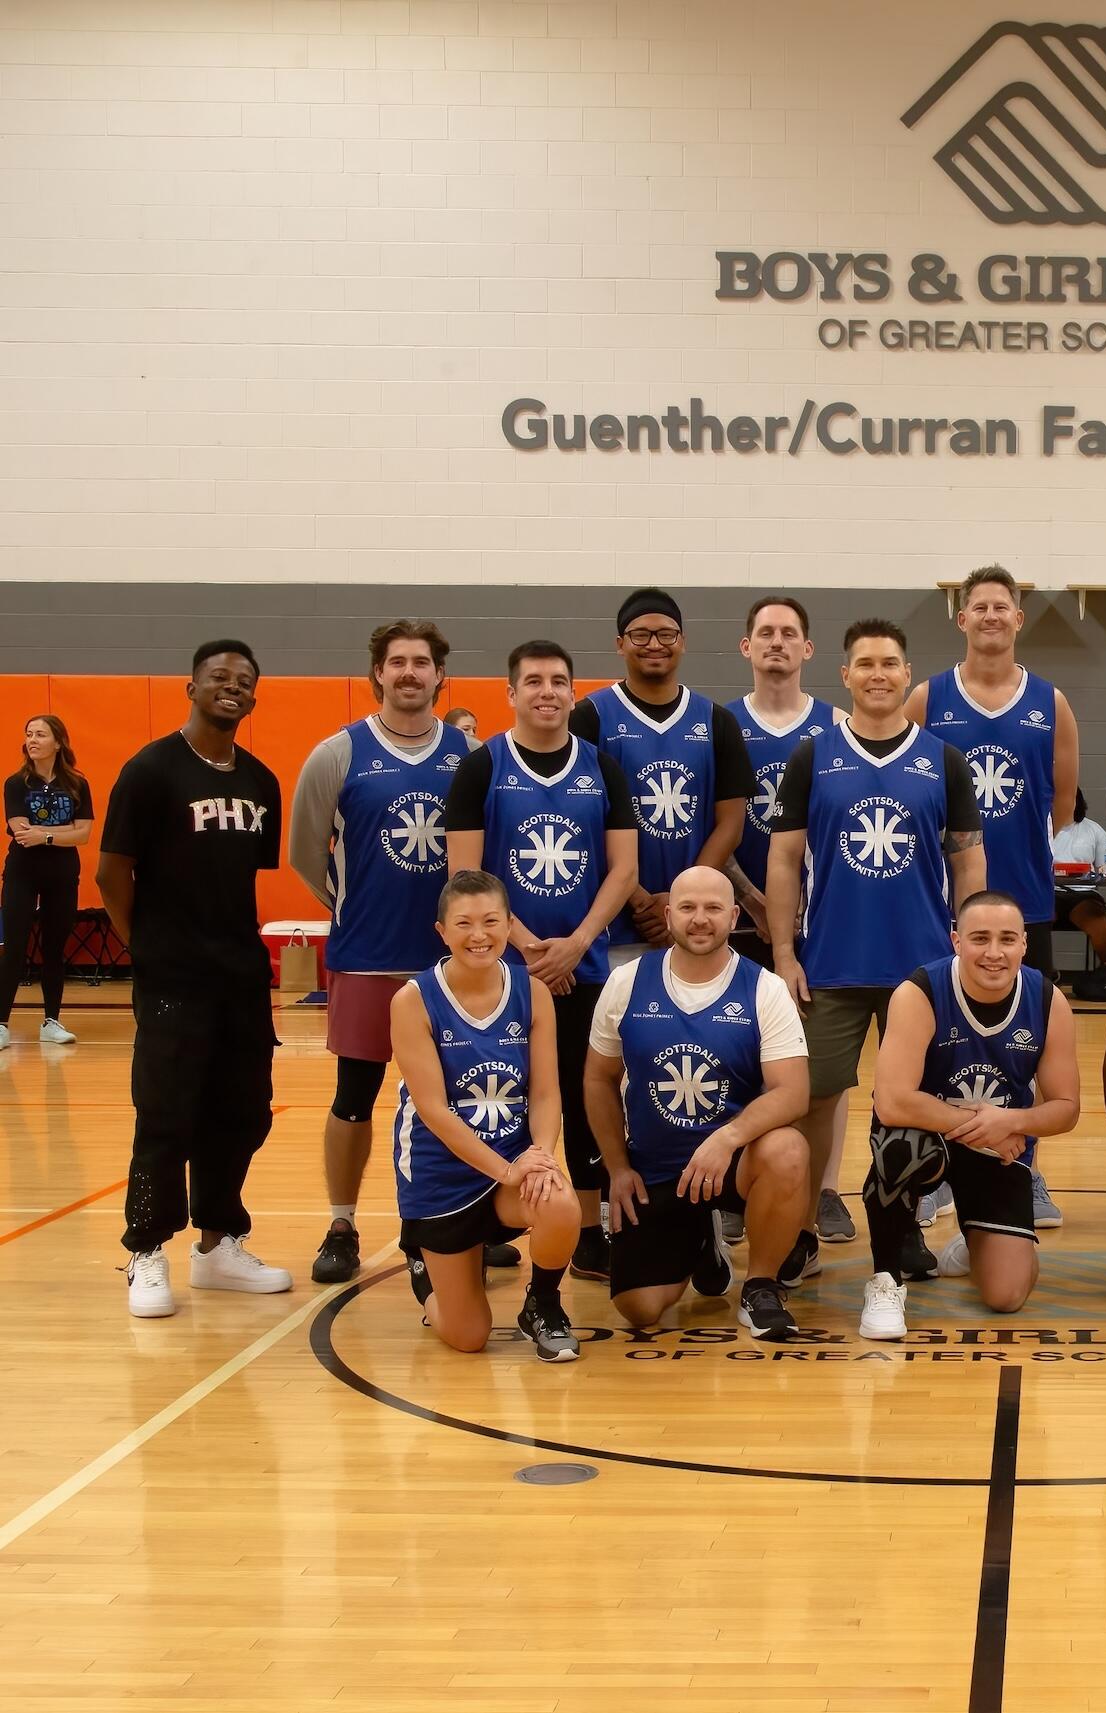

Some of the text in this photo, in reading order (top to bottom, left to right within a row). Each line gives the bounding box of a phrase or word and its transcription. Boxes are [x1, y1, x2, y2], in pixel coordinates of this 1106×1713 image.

[715, 251, 890, 301] BOYS
[907, 253, 963, 302] &
[818, 318, 868, 349] OF
[879, 319, 1048, 350] GREATER
[501, 397, 1017, 456] Guenther/Curran
[637, 760, 695, 780] SCOTTSDALE
[189, 798, 267, 835] PHX
[388, 792, 447, 814] SCOTTSDAL
[746, 798, 772, 835] OMMUNI
[849, 797, 911, 819] SCOTTSDALE
[993, 779, 1024, 818] ALL-STARS
[518, 814, 582, 836] SCOTTSDALE
[631, 797, 672, 840] COMMUNITY
[381, 829, 424, 873] COMMUNITY
[840, 831, 916, 878] COMMUNITY ALL-STARS
[509, 849, 588, 897] COMMUNITY ALL-STARS
[654, 1044, 720, 1067] SCOTTSDALE
[648, 1081, 694, 1127] COMMUNITY
[625, 1350, 705, 1360] OF
[726, 1350, 1008, 1361] GREATER
